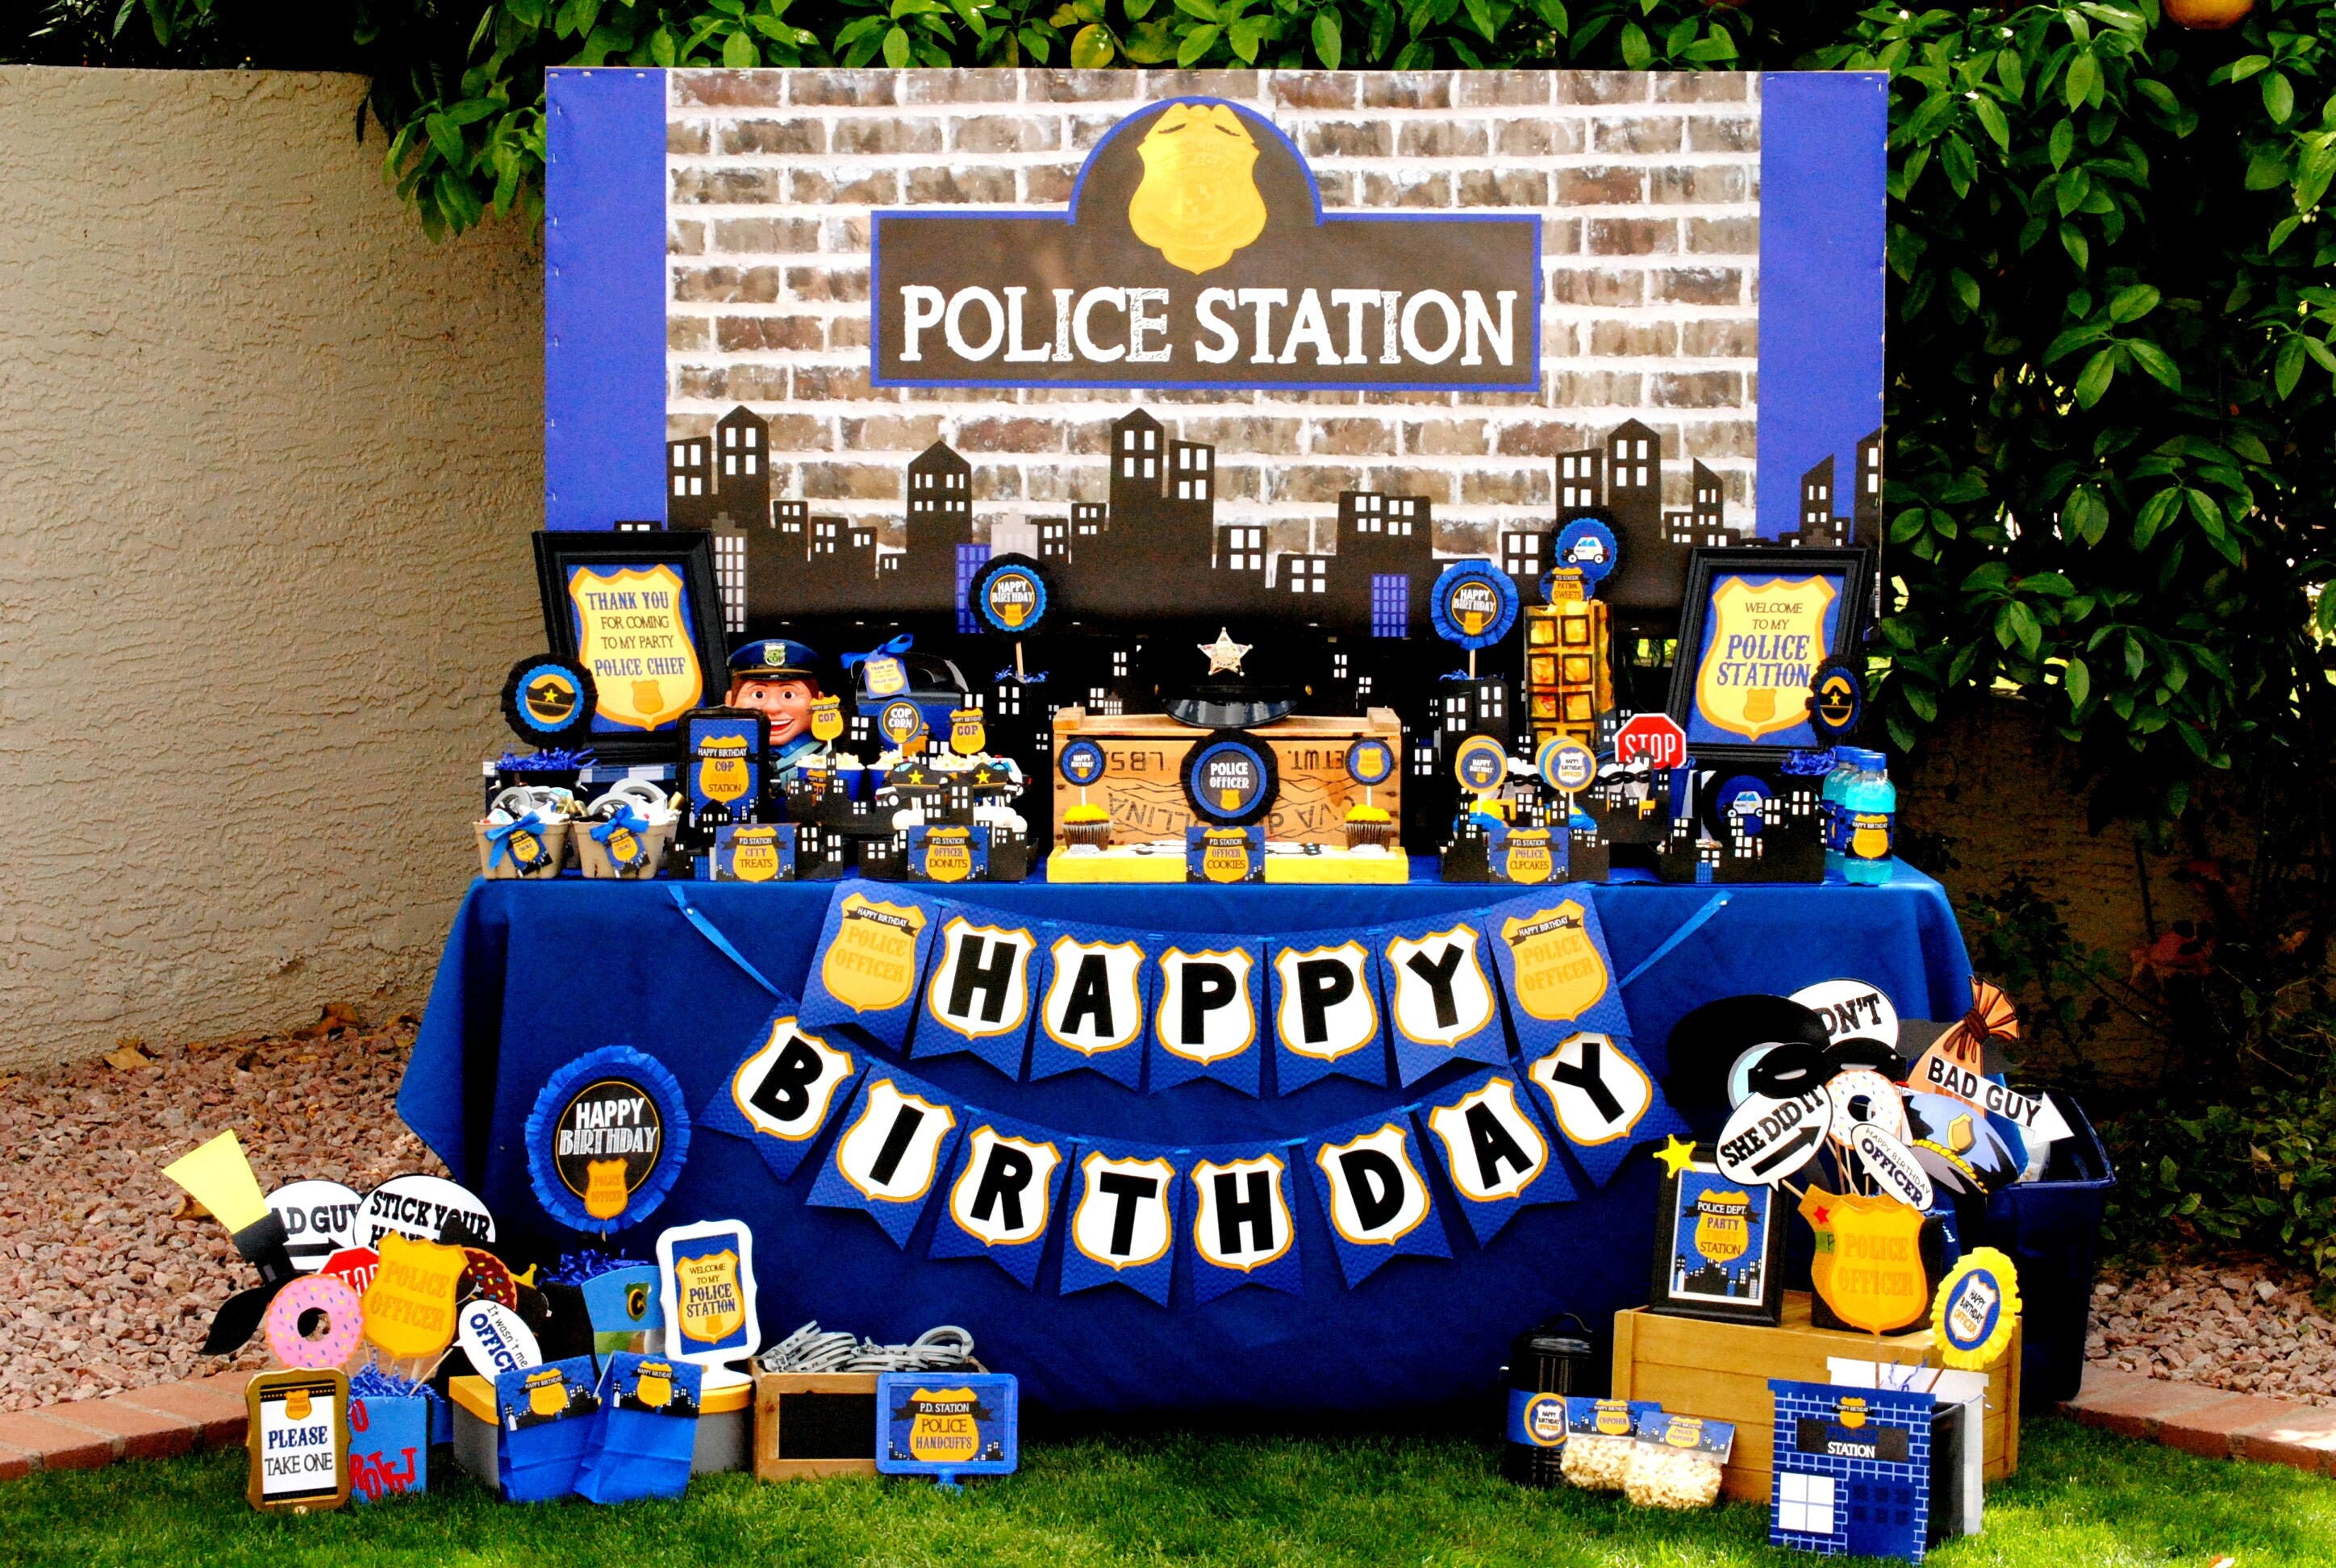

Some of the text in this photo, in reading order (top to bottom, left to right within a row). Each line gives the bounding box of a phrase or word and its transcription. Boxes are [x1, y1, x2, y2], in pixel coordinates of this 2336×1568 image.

[899, 286, 1517, 366] POLICE STATION
[998, 581, 1028, 592] HAPPY
[1460, 589, 1490, 600] HAPPY
[586, 591, 669, 611] THANK YOU
[992, 592, 1033, 603] BIRTHDAY
[1453, 597, 1495, 612] BIRTHDAY
[1746, 603, 1803, 614] WELCOME
[602, 615, 669, 629] FOR COMING
[1752, 619, 1790, 630] TO MY
[601, 636, 674, 649] TO MY PARTY
[1725, 634, 1810, 661] POLICE
[594, 657, 686, 677] POLICE CHIEF
[1717, 662, 1812, 687] STATION
[818, 713, 836, 722] COP
[891, 708, 911, 718] COP
[888, 718, 912, 728] CORN
[957, 725, 978, 736] COP
[698, 748, 748, 757] HAPPY BIRTHDAY
[1625, 733, 1676, 764] STOP
[715, 761, 734, 772] COP
[1325, 750, 1345, 769] ET
[1472, 757, 1491, 767] HAPPY
[1210, 762, 1248, 775] POLICE
[708, 784, 741, 792] STATION
[1209, 776, 1249, 789] OFFICER
[1522, 839, 1546, 847] STATION
[745, 849, 766, 857] CITY
[935, 848, 962, 857] OFFICER
[1212, 849, 1241, 857] OFFICER
[1515, 849, 1544, 859] POLICE
[740, 859, 773, 869] TREATS
[929, 859, 968, 868] DONUTS
[1207, 860, 1245, 869] COOKIES
[1509, 860, 1550, 870] CUPCAKES
[857, 907, 908, 927] HAPPY BIRTHDAY
[1519, 915, 1569, 936] HAPPY BIRTHDAY
[847, 925, 907, 957] POLICE
[1521, 934, 1582, 966] POLICE
[835, 948, 904, 982] OFFICER
[1523, 957, 1595, 991] OFFICER
[956, 932, 1468, 1047] HAPPY
[1926, 1056, 2041, 1128] BAD GUY
[575, 1098, 645, 1129] HAPPY
[1720, 1088, 1825, 1169] SHE DID IT
[559, 1127, 659, 1156] BIRTHDAY
[748, 1029, 1628, 1256] BIRTHDAY
[1866, 1128, 1931, 1195] HAPPY BIRTHDAY
[1862, 1138, 1923, 1207] OFFICER
[370, 1190, 433, 1227] STICK
[1697, 1201, 1747, 1215] POLICE DEPT.
[271, 1207, 307, 1235] AD
[1707, 1218, 1739, 1230] PARTY
[1700, 1242, 1742, 1254] STATION
[1844, 1232, 1909, 1261] POLICE
[690, 1263, 726, 1274] WELCOME
[328, 1264, 379, 1297] TO
[383, 1259, 453, 1299] POLICE
[697, 1275, 720, 1285] TO MY
[1838, 1267, 1914, 1296] OFFICER
[689, 1283, 732, 1303] POLICE
[1969, 1290, 1986, 1309] HAPPY
[369, 1291, 447, 1332] OFFICER
[687, 1299, 736, 1318] STATION
[1959, 1297, 1984, 1324] BIRTHDAY
[1954, 1309, 1977, 1336] OFFICER
[469, 1313, 519, 1373] OFFIC
[487, 1304, 528, 1367] It wasn't me
[637, 1367, 672, 1378] HAPPY BIRTHDAY
[525, 1375, 562, 1390] HAPPY BIRTHDAY
[920, 1403, 970, 1412] P.D. STATION
[921, 1419, 968, 1433] POLICE
[269, 1426, 327, 1449] PLEASE
[916, 1437, 972, 1449] HANDCUFFS
[1828, 1441, 1875, 1458] STATION
[265, 1452, 333, 1477] TAKE ONE
